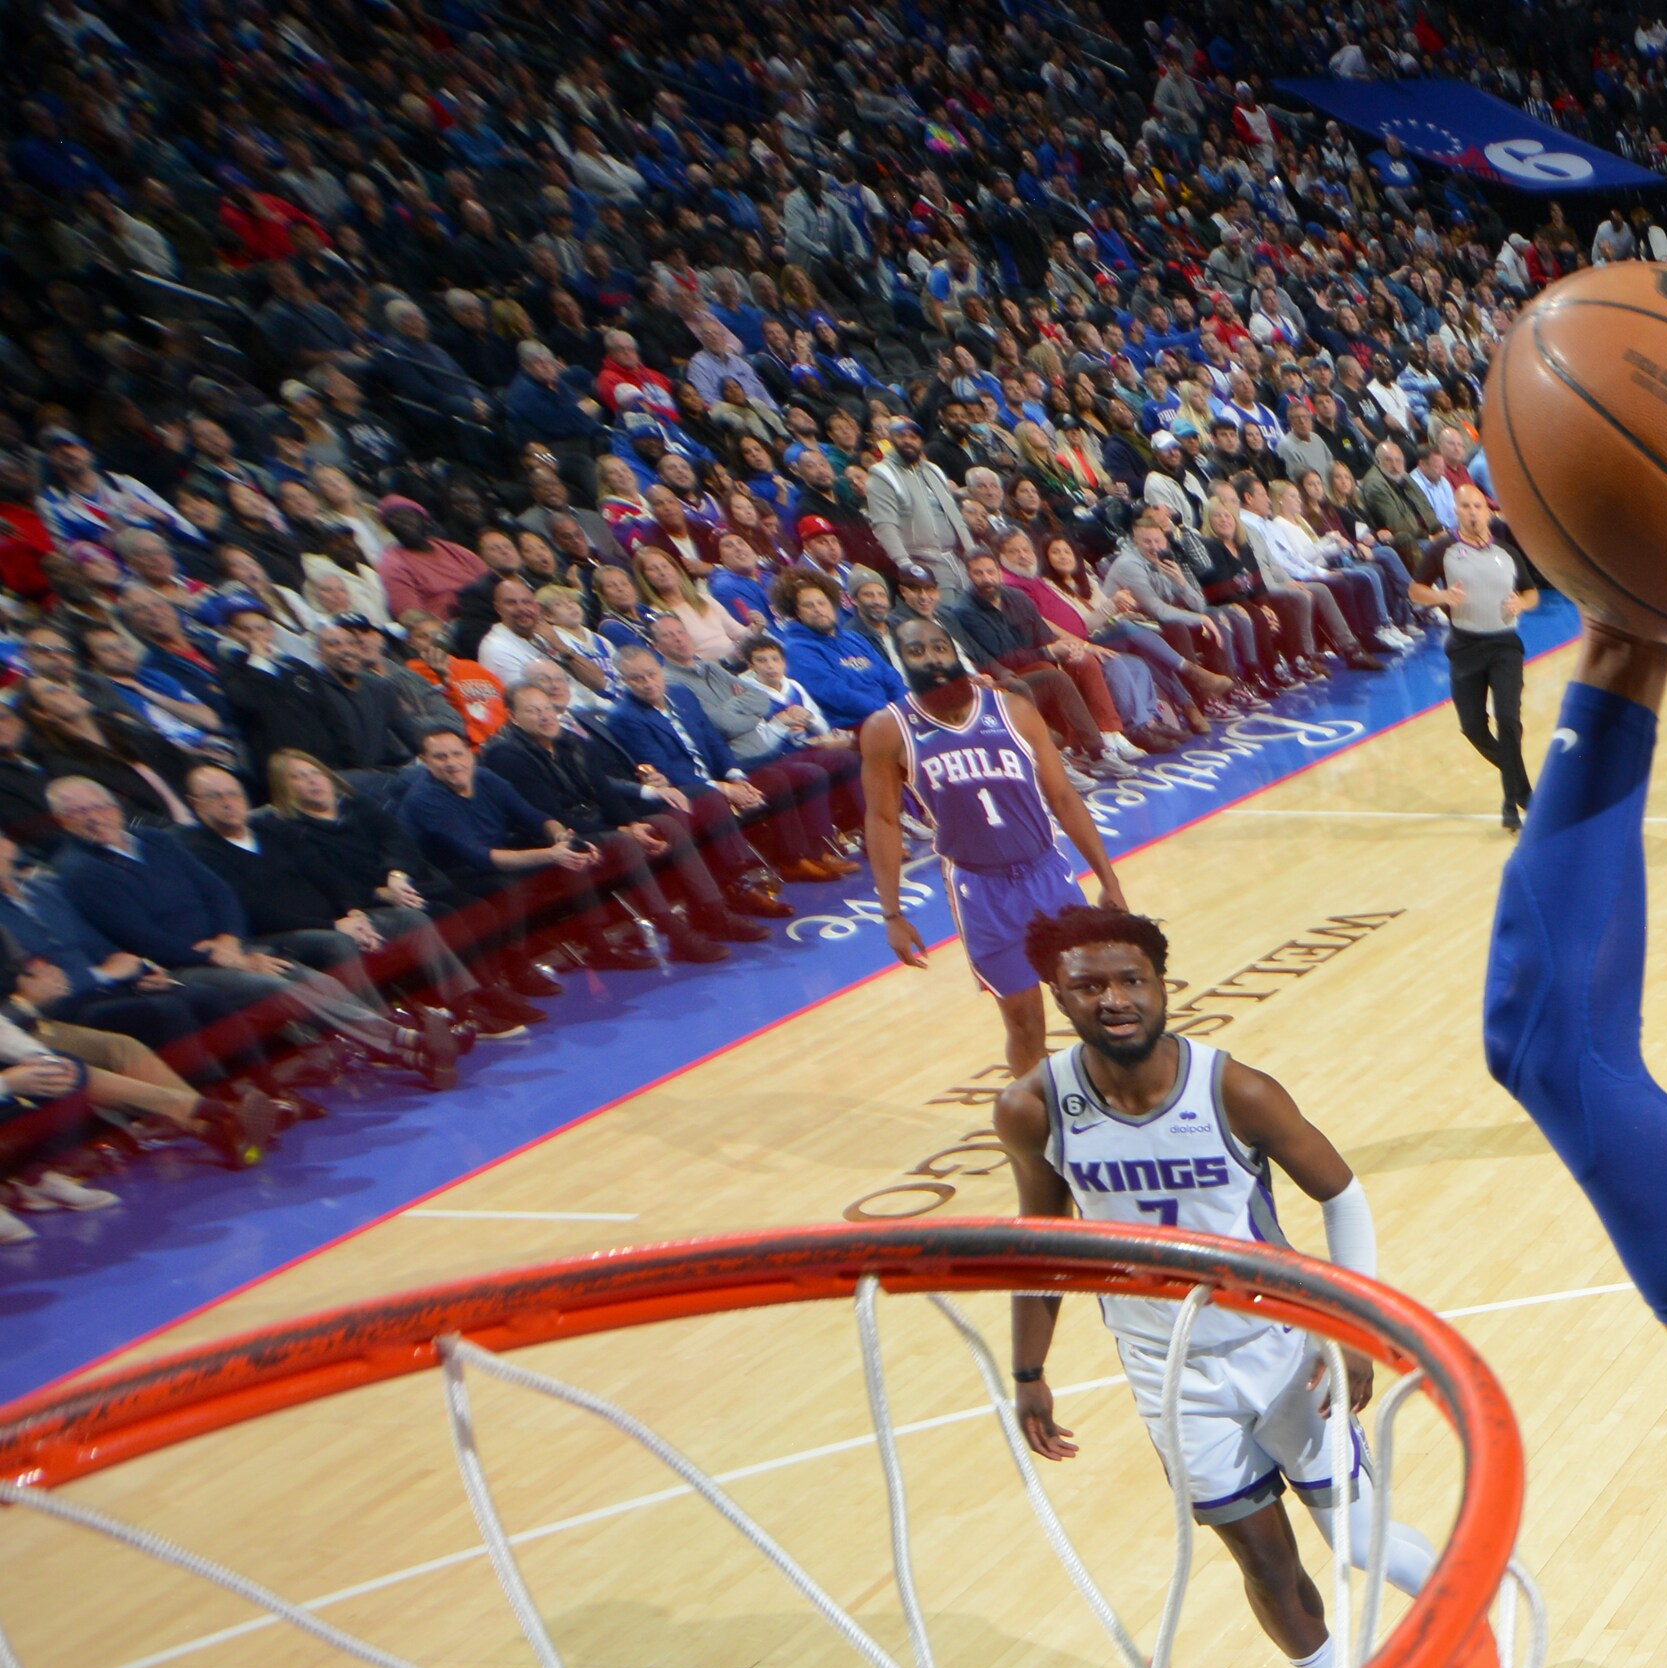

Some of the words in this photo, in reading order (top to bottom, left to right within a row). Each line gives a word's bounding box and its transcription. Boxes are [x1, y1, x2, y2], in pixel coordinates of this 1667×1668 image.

[921, 748, 1025, 792] PHILA
[977, 788, 1004, 827] 1
[1064, 1094, 1082, 1115] 6
[1169, 1121, 1213, 1137] dialpad
[1067, 1153, 1231, 1194] KINGS
